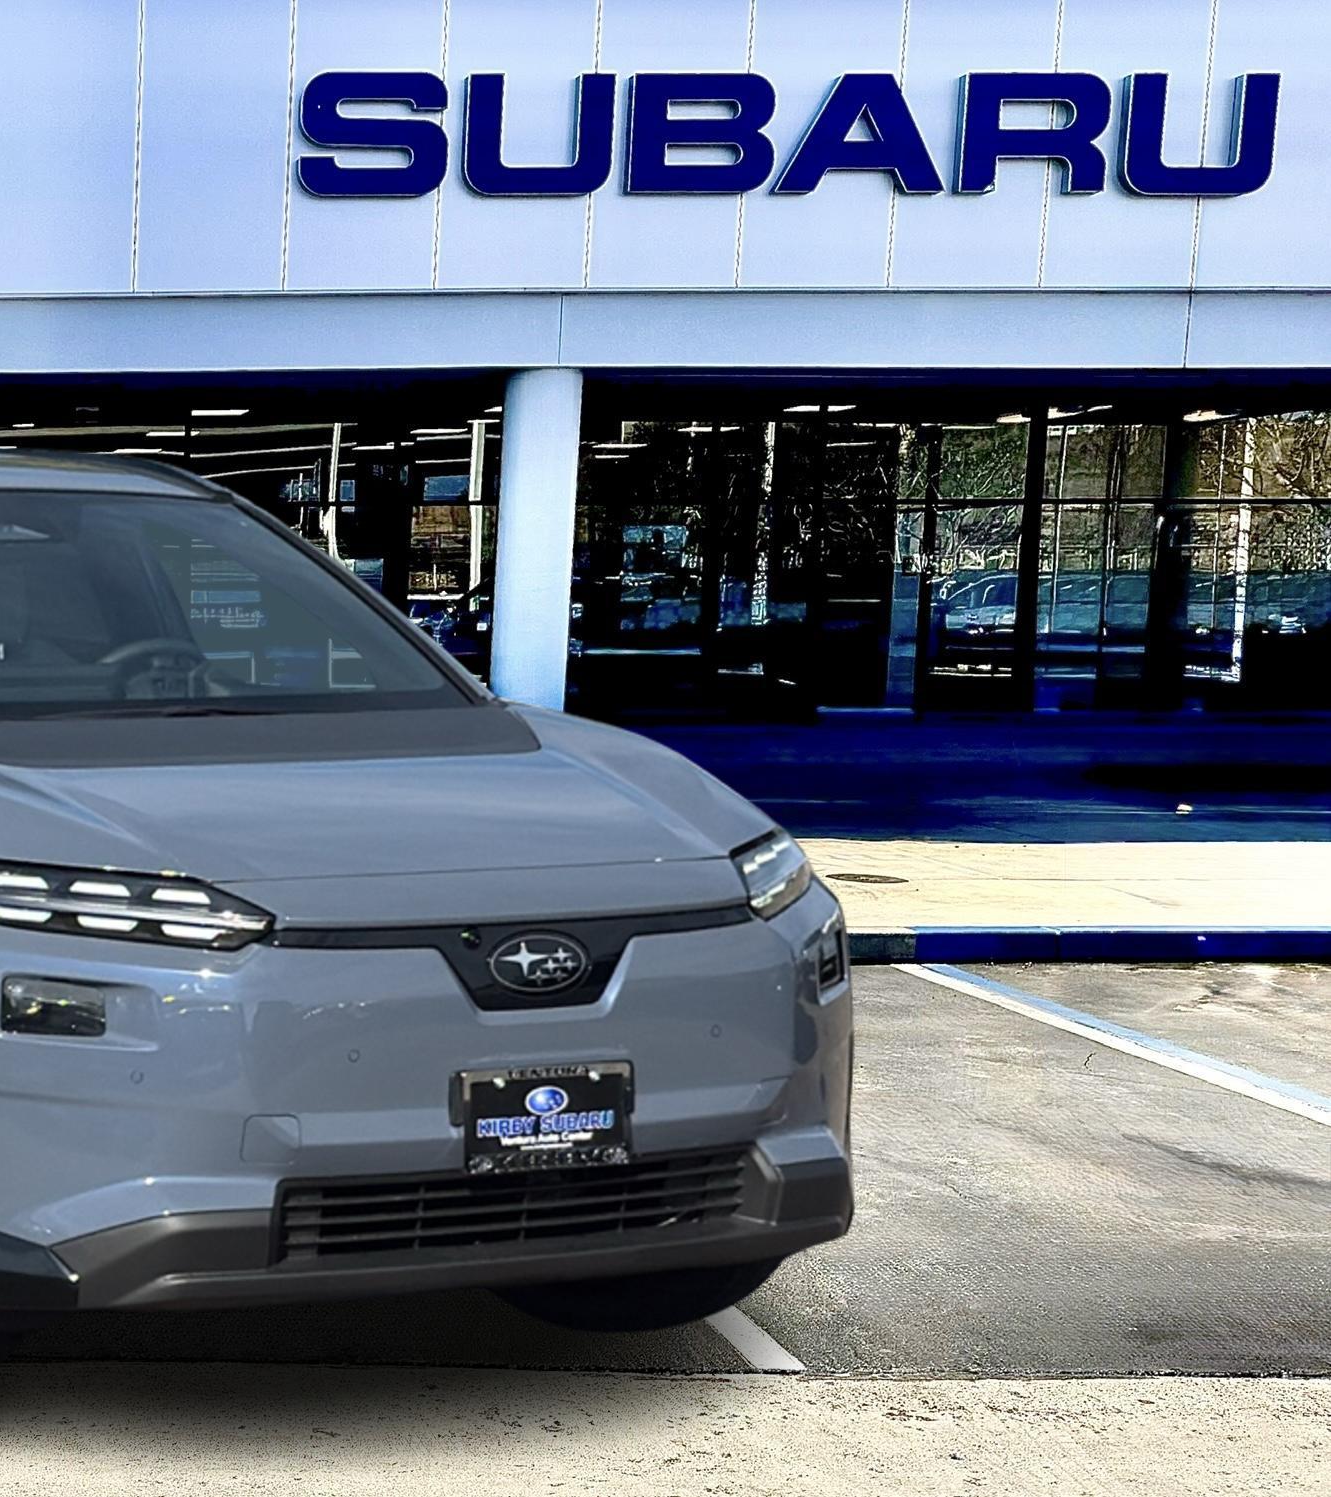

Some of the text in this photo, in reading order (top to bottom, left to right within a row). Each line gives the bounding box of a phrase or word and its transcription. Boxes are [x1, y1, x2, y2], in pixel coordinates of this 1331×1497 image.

[297, 71, 1280, 199] SUBARU
[477, 1110, 615, 1137] KIRBY SUBARU
